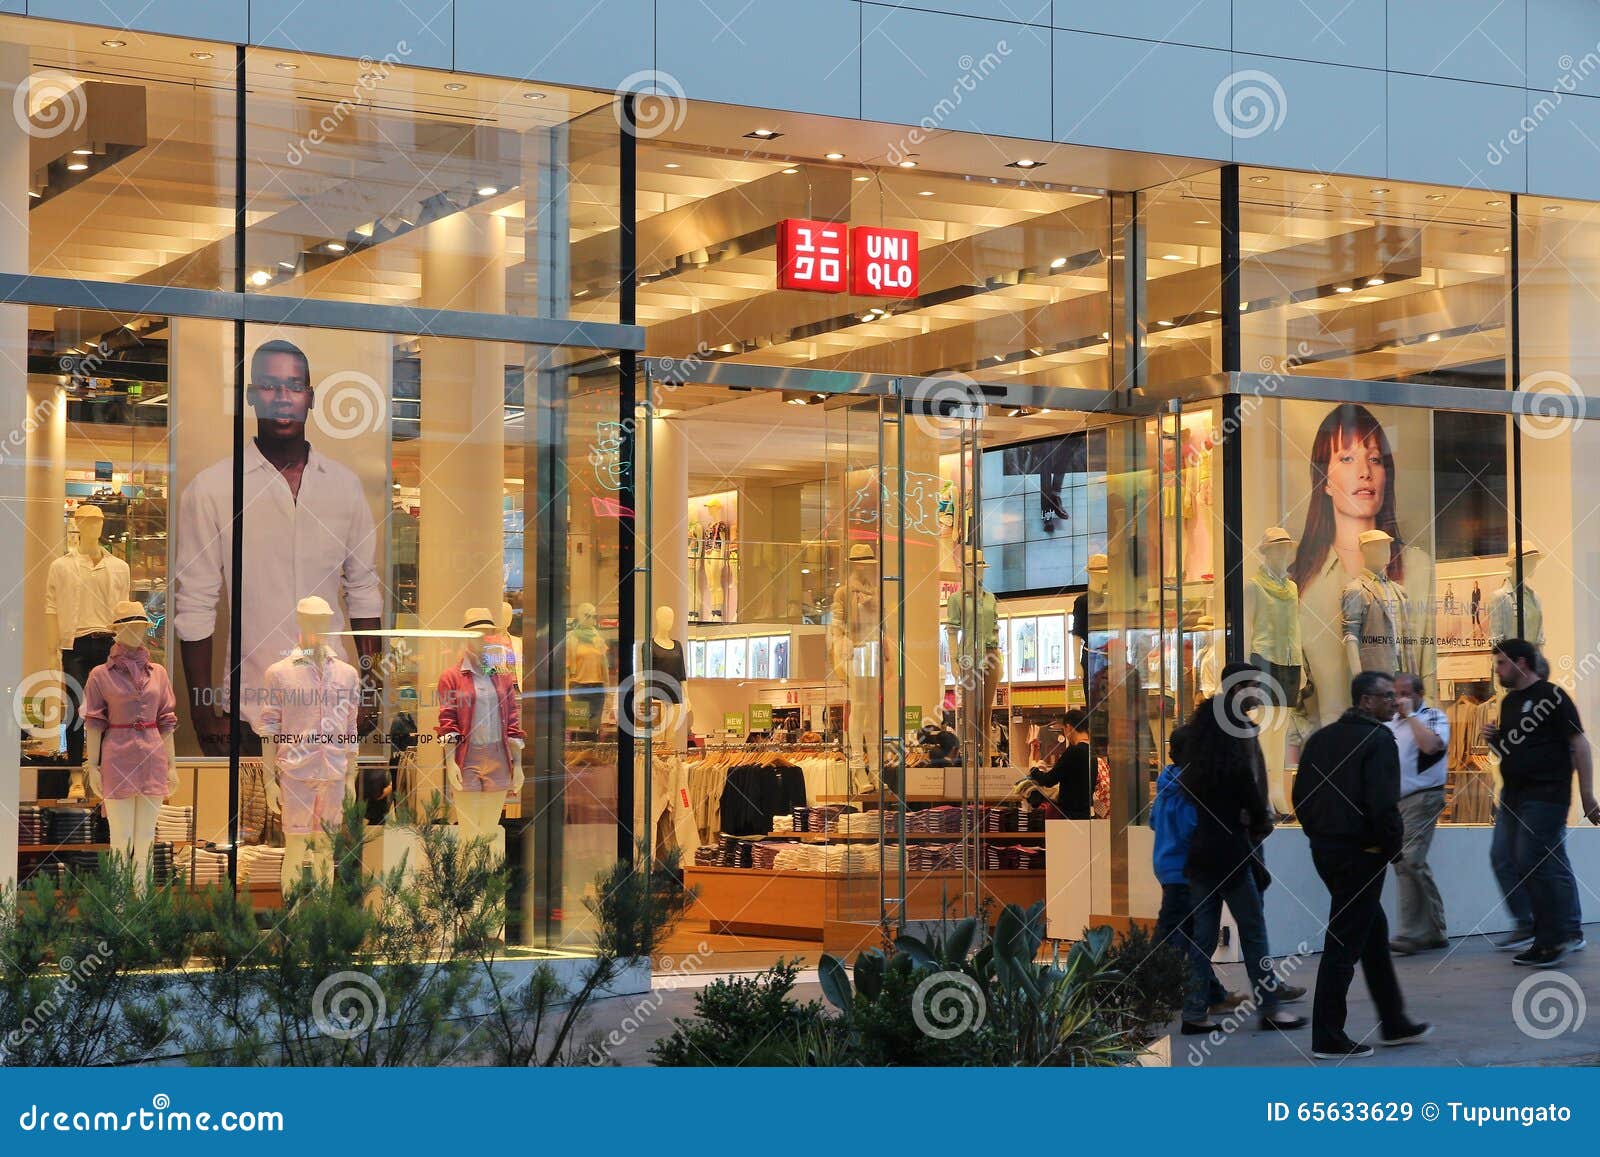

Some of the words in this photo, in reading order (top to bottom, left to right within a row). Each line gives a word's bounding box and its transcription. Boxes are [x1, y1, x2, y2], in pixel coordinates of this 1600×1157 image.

[796, 228, 839, 254] ユニ
[867, 235, 908, 262] UNI
[867, 262, 912, 290] QLO
[1420, 637, 1435, 646] BRA
[1473, 639, 1486, 647] TOP
[244, 688, 329, 707] PREMIUM
[419, 688, 473, 708] LINEN
[726, 717, 744, 726] NEW
[752, 710, 769, 719] NEW
[273, 734, 304, 745] CREW
[307, 734, 334, 745] NECK
[338, 734, 368, 745] SHORT
[416, 734, 433, 745] TOP
